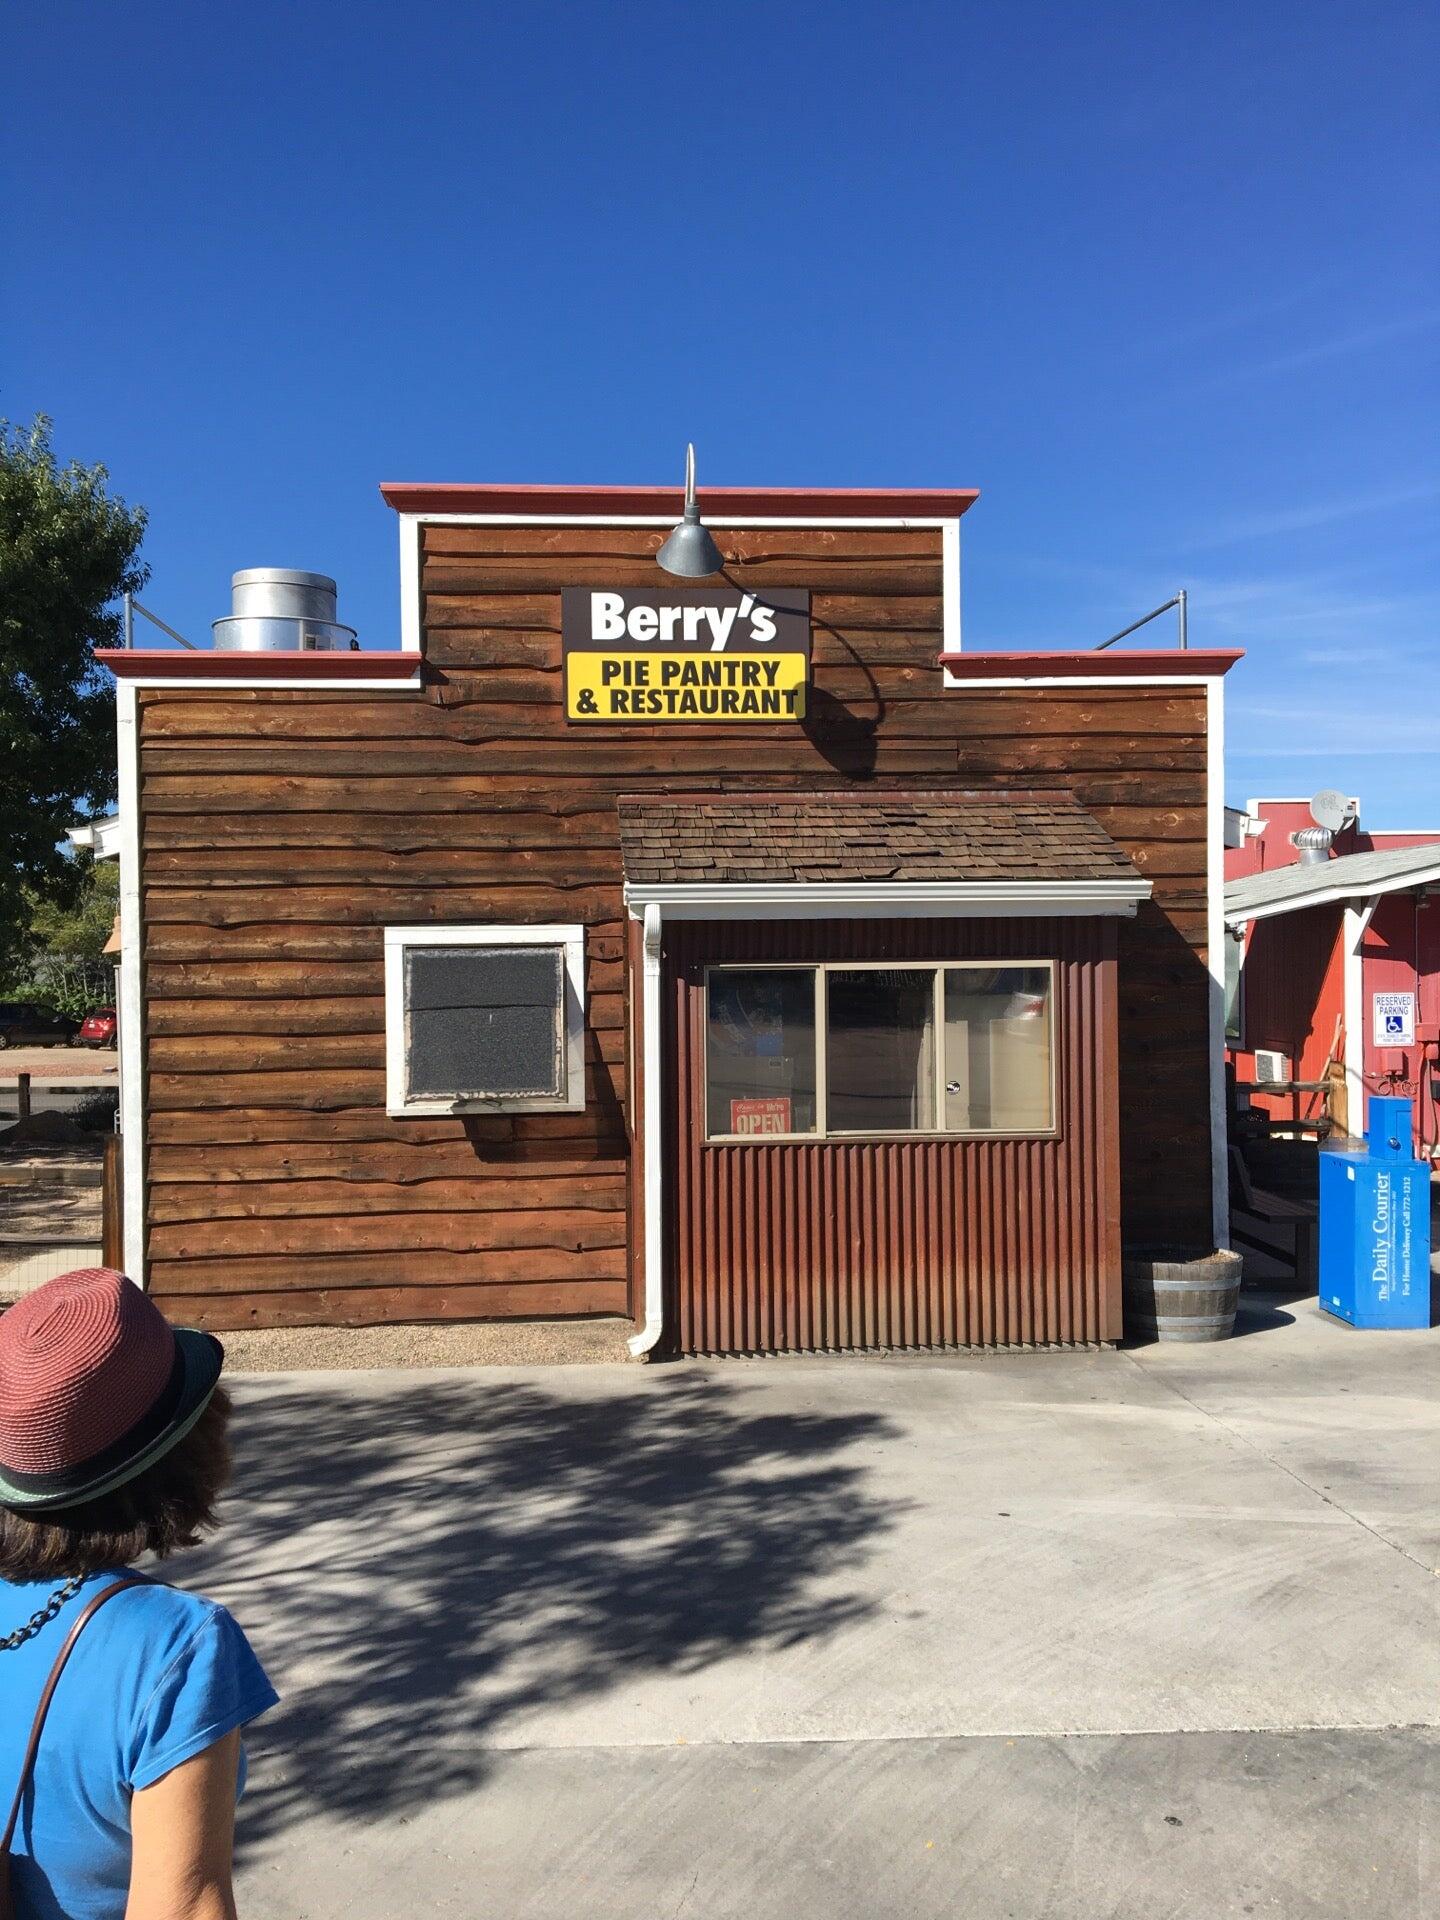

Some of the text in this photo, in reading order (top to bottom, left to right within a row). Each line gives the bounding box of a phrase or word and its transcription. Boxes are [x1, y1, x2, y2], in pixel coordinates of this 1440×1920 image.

[590, 592, 777, 652] Berry's
[601, 660, 781, 686] PIE PANTRY
[575, 688, 799, 714] & RESTAURANT
[1376, 996, 1411, 1006] RESERVED
[1379, 1006, 1409, 1015] PARKING
[736, 1113, 785, 1134] OPEN
[1402, 1211, 1411, 1226] Call
[1372, 1172, 1391, 1301] The Daily Courier
[1402, 1227, 1412, 1257] Delivery
[1402, 1259, 1411, 1282] Home
[1402, 1283, 1411, 1296] For
